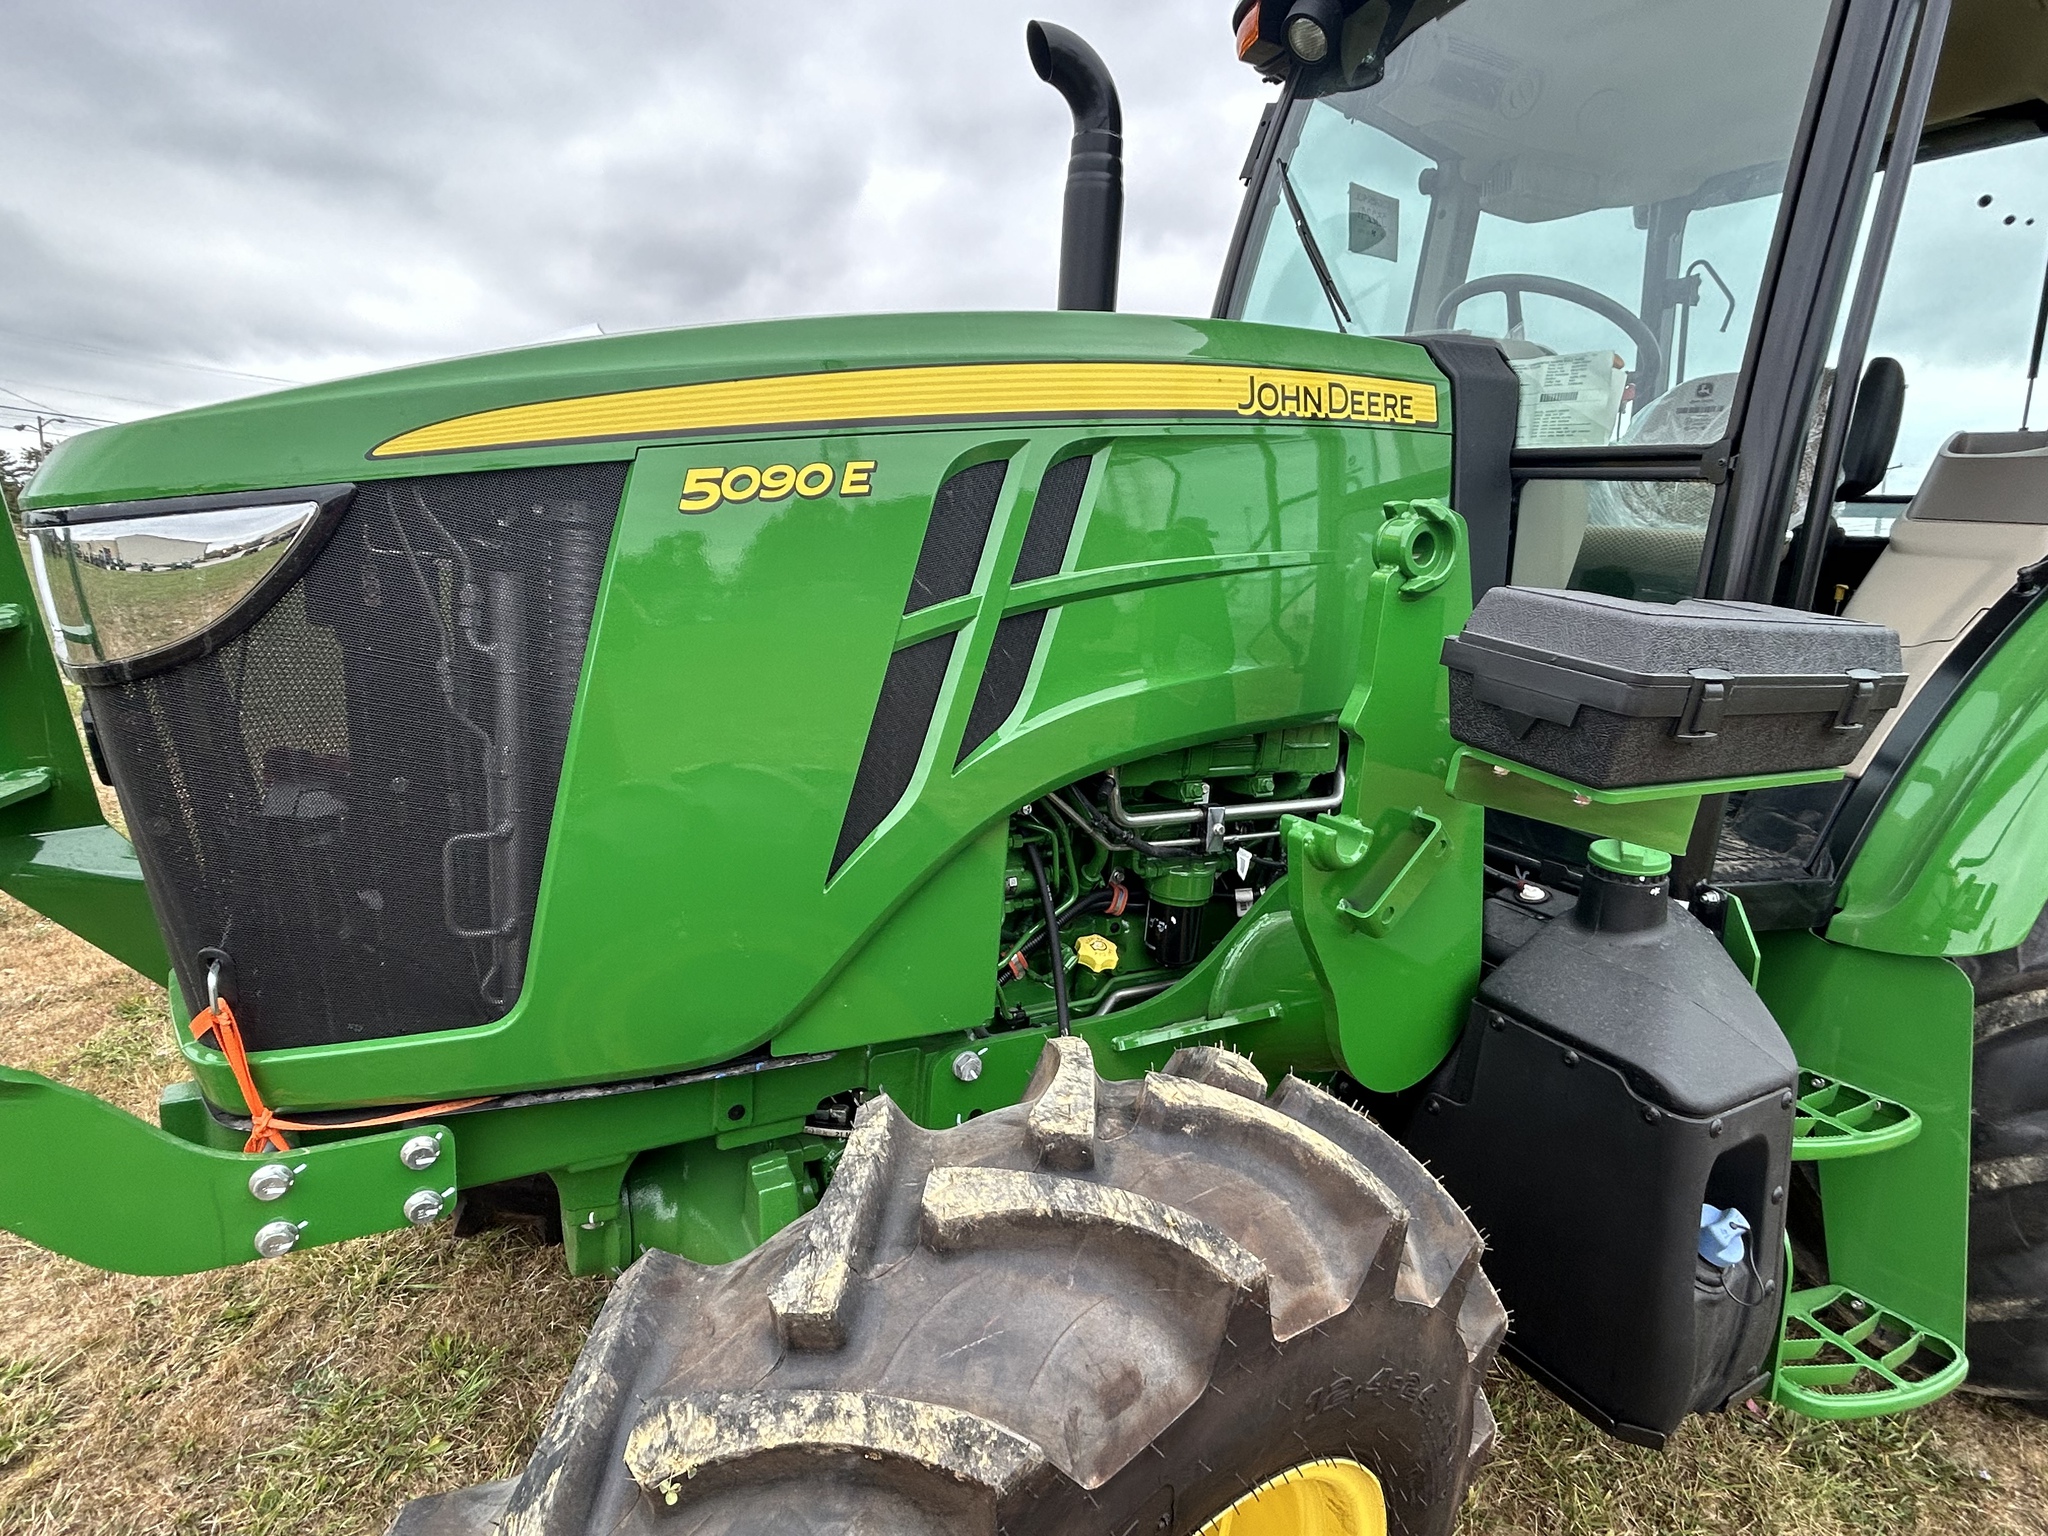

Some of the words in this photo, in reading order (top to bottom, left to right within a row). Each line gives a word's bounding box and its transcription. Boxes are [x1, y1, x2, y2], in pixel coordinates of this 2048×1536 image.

[1237, 375, 1323, 414] JOHN
[1328, 382, 1414, 420] DEERE
[678, 463, 836, 514] 5090
[839, 459, 878, 497] E
